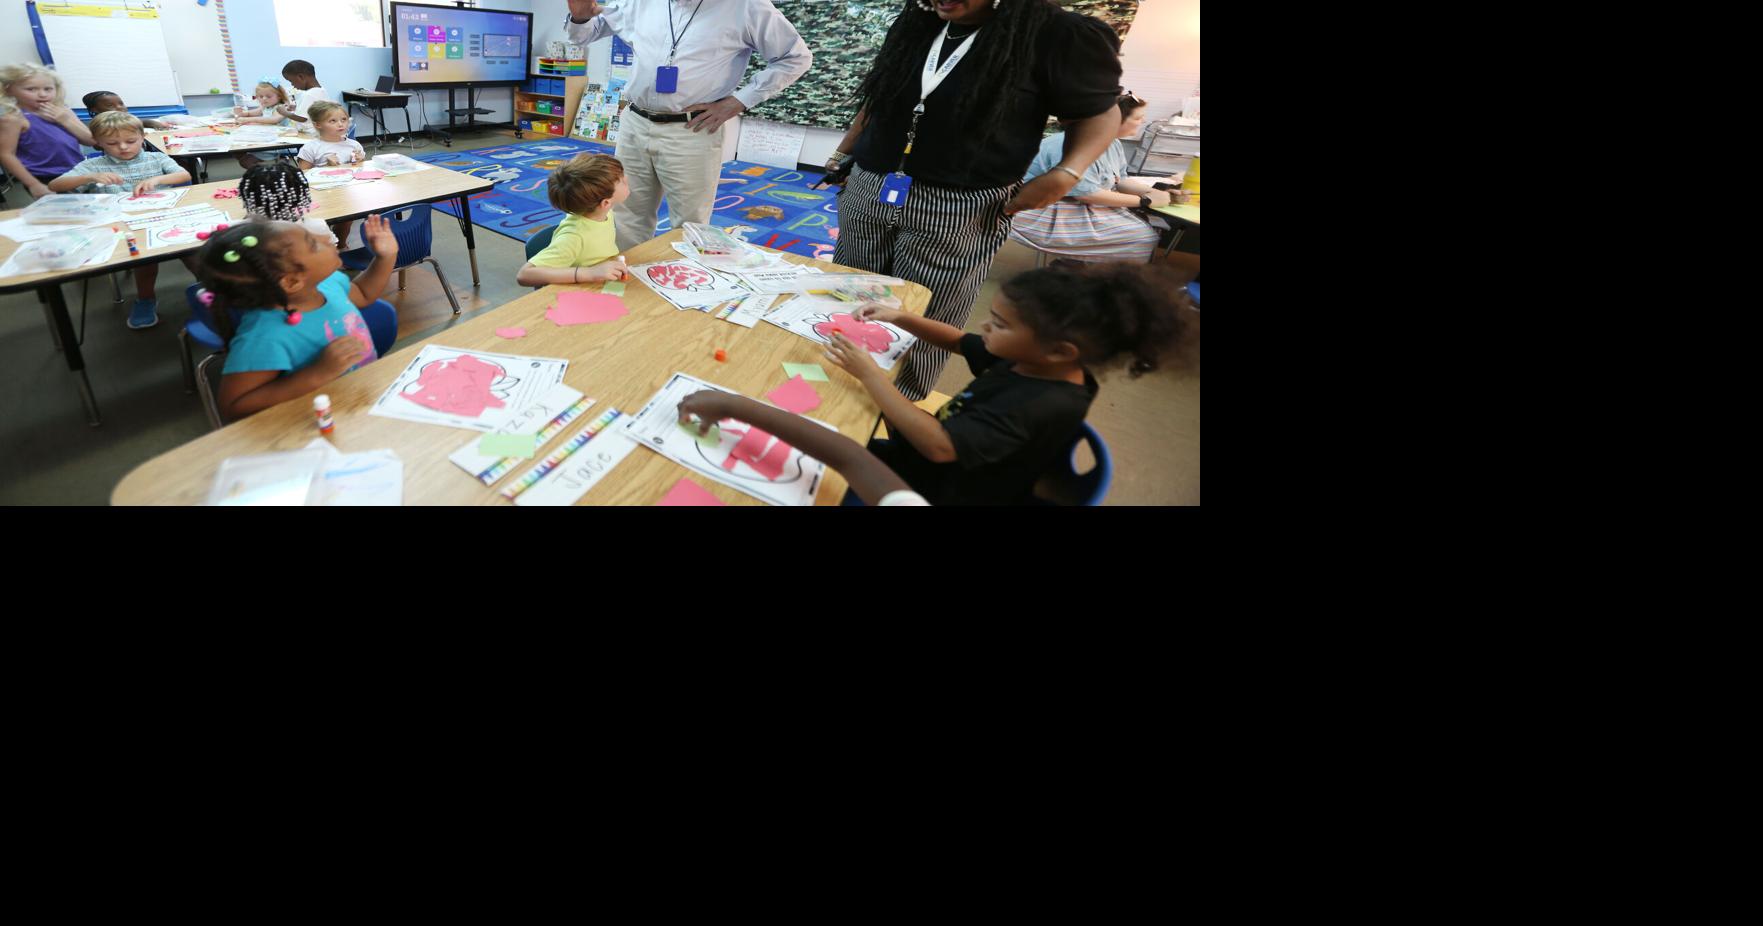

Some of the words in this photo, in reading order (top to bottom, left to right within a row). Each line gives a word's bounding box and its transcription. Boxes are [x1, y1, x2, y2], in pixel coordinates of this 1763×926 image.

[772, 171, 804, 182] D
[787, 213, 829, 230] P
[551, 451, 613, 490] Jace
